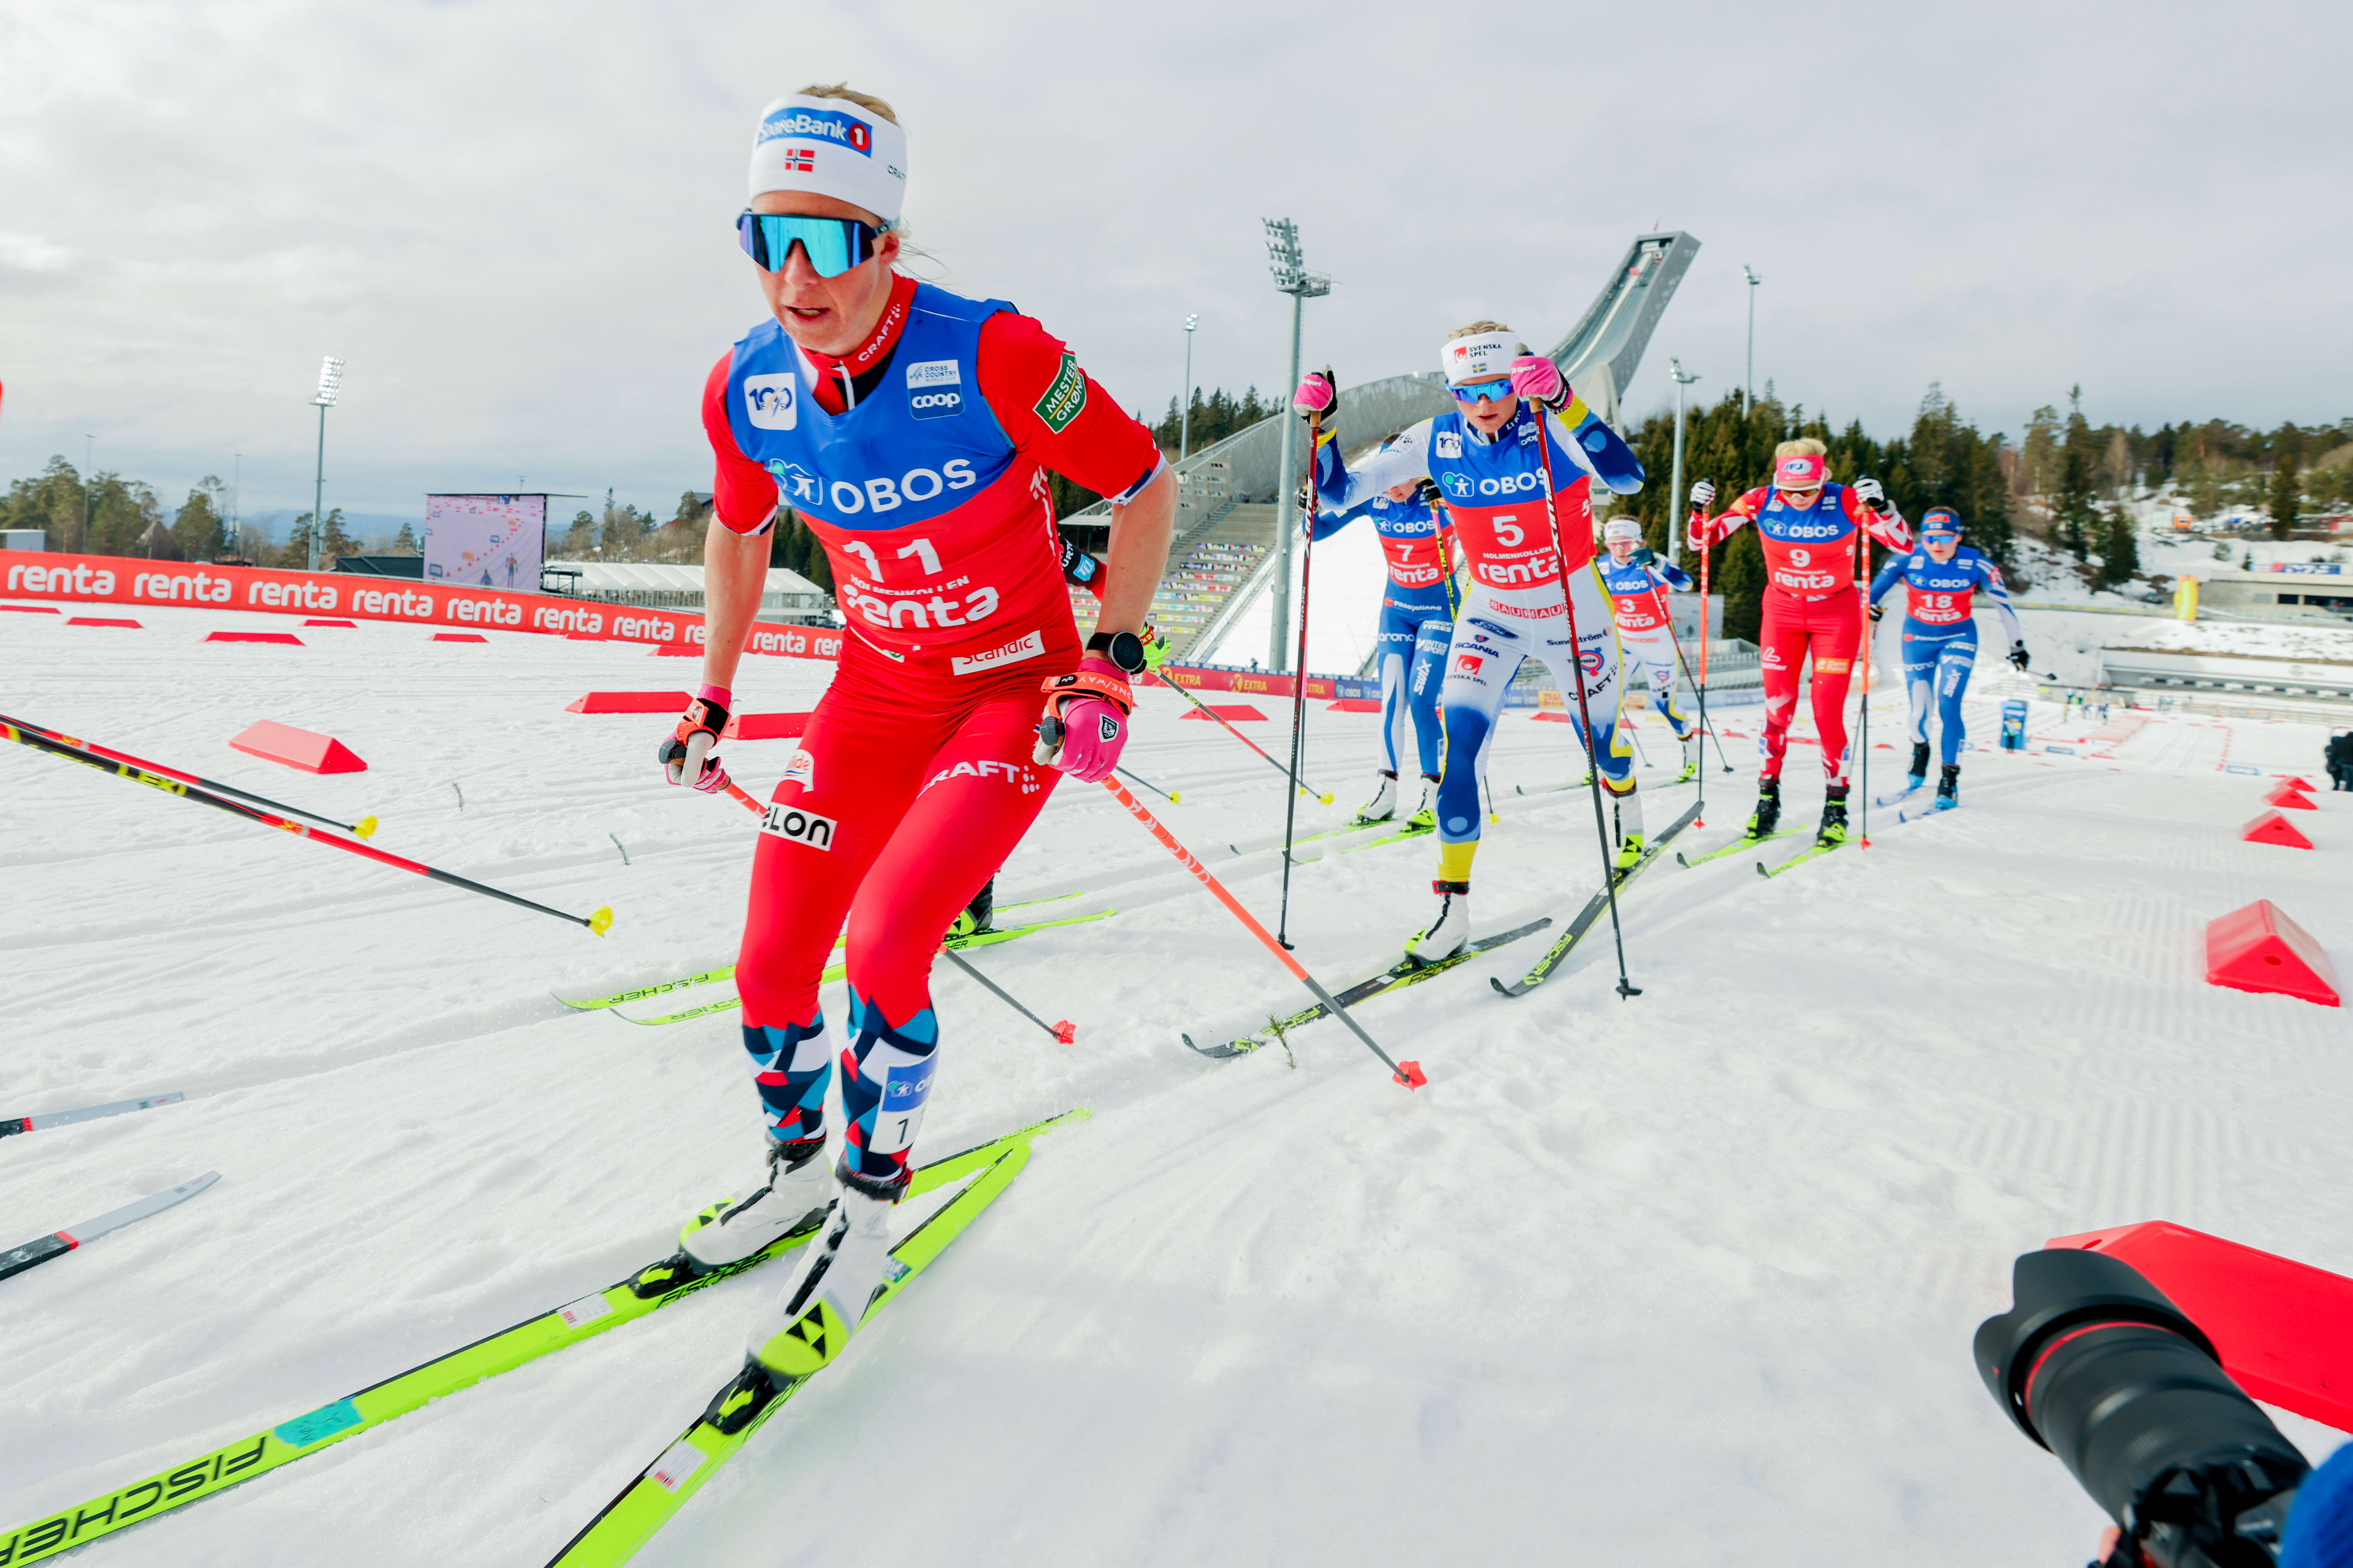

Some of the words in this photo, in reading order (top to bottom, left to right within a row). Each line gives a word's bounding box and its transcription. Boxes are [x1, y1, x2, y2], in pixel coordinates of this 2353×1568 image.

[854, 128, 864, 146] 1
[858, 316, 894, 362] CRAFT
[1469, 343, 1502, 352] SVENSKA
[1045, 360, 1077, 412] MESTER
[911, 392, 961, 409] coop
[831, 459, 976, 514] OBOS
[1479, 467, 1547, 496] OBOS
[1393, 520, 1436, 533] OBOS
[1492, 515, 1525, 547] 5
[1789, 524, 1839, 538] OBOS
[1396, 544, 1414, 562] 7
[1483, 545, 1552, 560] HOLMENKOLLEN
[1790, 548, 1811, 568] 9
[1846, 544, 1854, 556] 9
[841, 538, 943, 583] 11
[1478, 554, 1568, 584] renta
[8, 563, 116, 595] renta
[1389, 565, 1439, 584] renta
[1774, 572, 1835, 589] renta
[1928, 578, 1970, 588] OBOS
[134, 572, 232, 602] renta
[1615, 580, 1649, 591] OBOS
[248, 580, 338, 610] renta
[352, 589, 433, 618] renta
[1921, 594, 1953, 609] 18
[447, 598, 522, 625] renta
[842, 586, 1000, 629] renta
[1394, 599, 1442, 612] Pihlajalinna
[1490, 601, 1575, 619] BAUHAU
[1620, 598, 1636, 613] 3
[533, 607, 603, 634] renta
[1615, 616, 1655, 628] renta
[1914, 608, 1962, 623] renta
[612, 616, 675, 641] renta
[1422, 624, 1452, 633] TYRES
[752, 631, 806, 653] renta
[1426, 639, 1449, 649] INTER
[1546, 632, 1603, 645] Suntröm
[1422, 644, 1447, 656] SPORT
[1454, 642, 1499, 658] SCANIA
[1174, 674, 1201, 686] EXTRA
[1244, 680, 1267, 691] EXTRA
[1473, 677, 1488, 686] SPEL
[1569, 674, 1612, 700] CAFT
[116, 763, 188, 797] LEKI
[1531, 933, 1573, 975] FISCHER
[607, 973, 709, 1004] FISCHER
[657, 1253, 771, 1309] FISCHER
